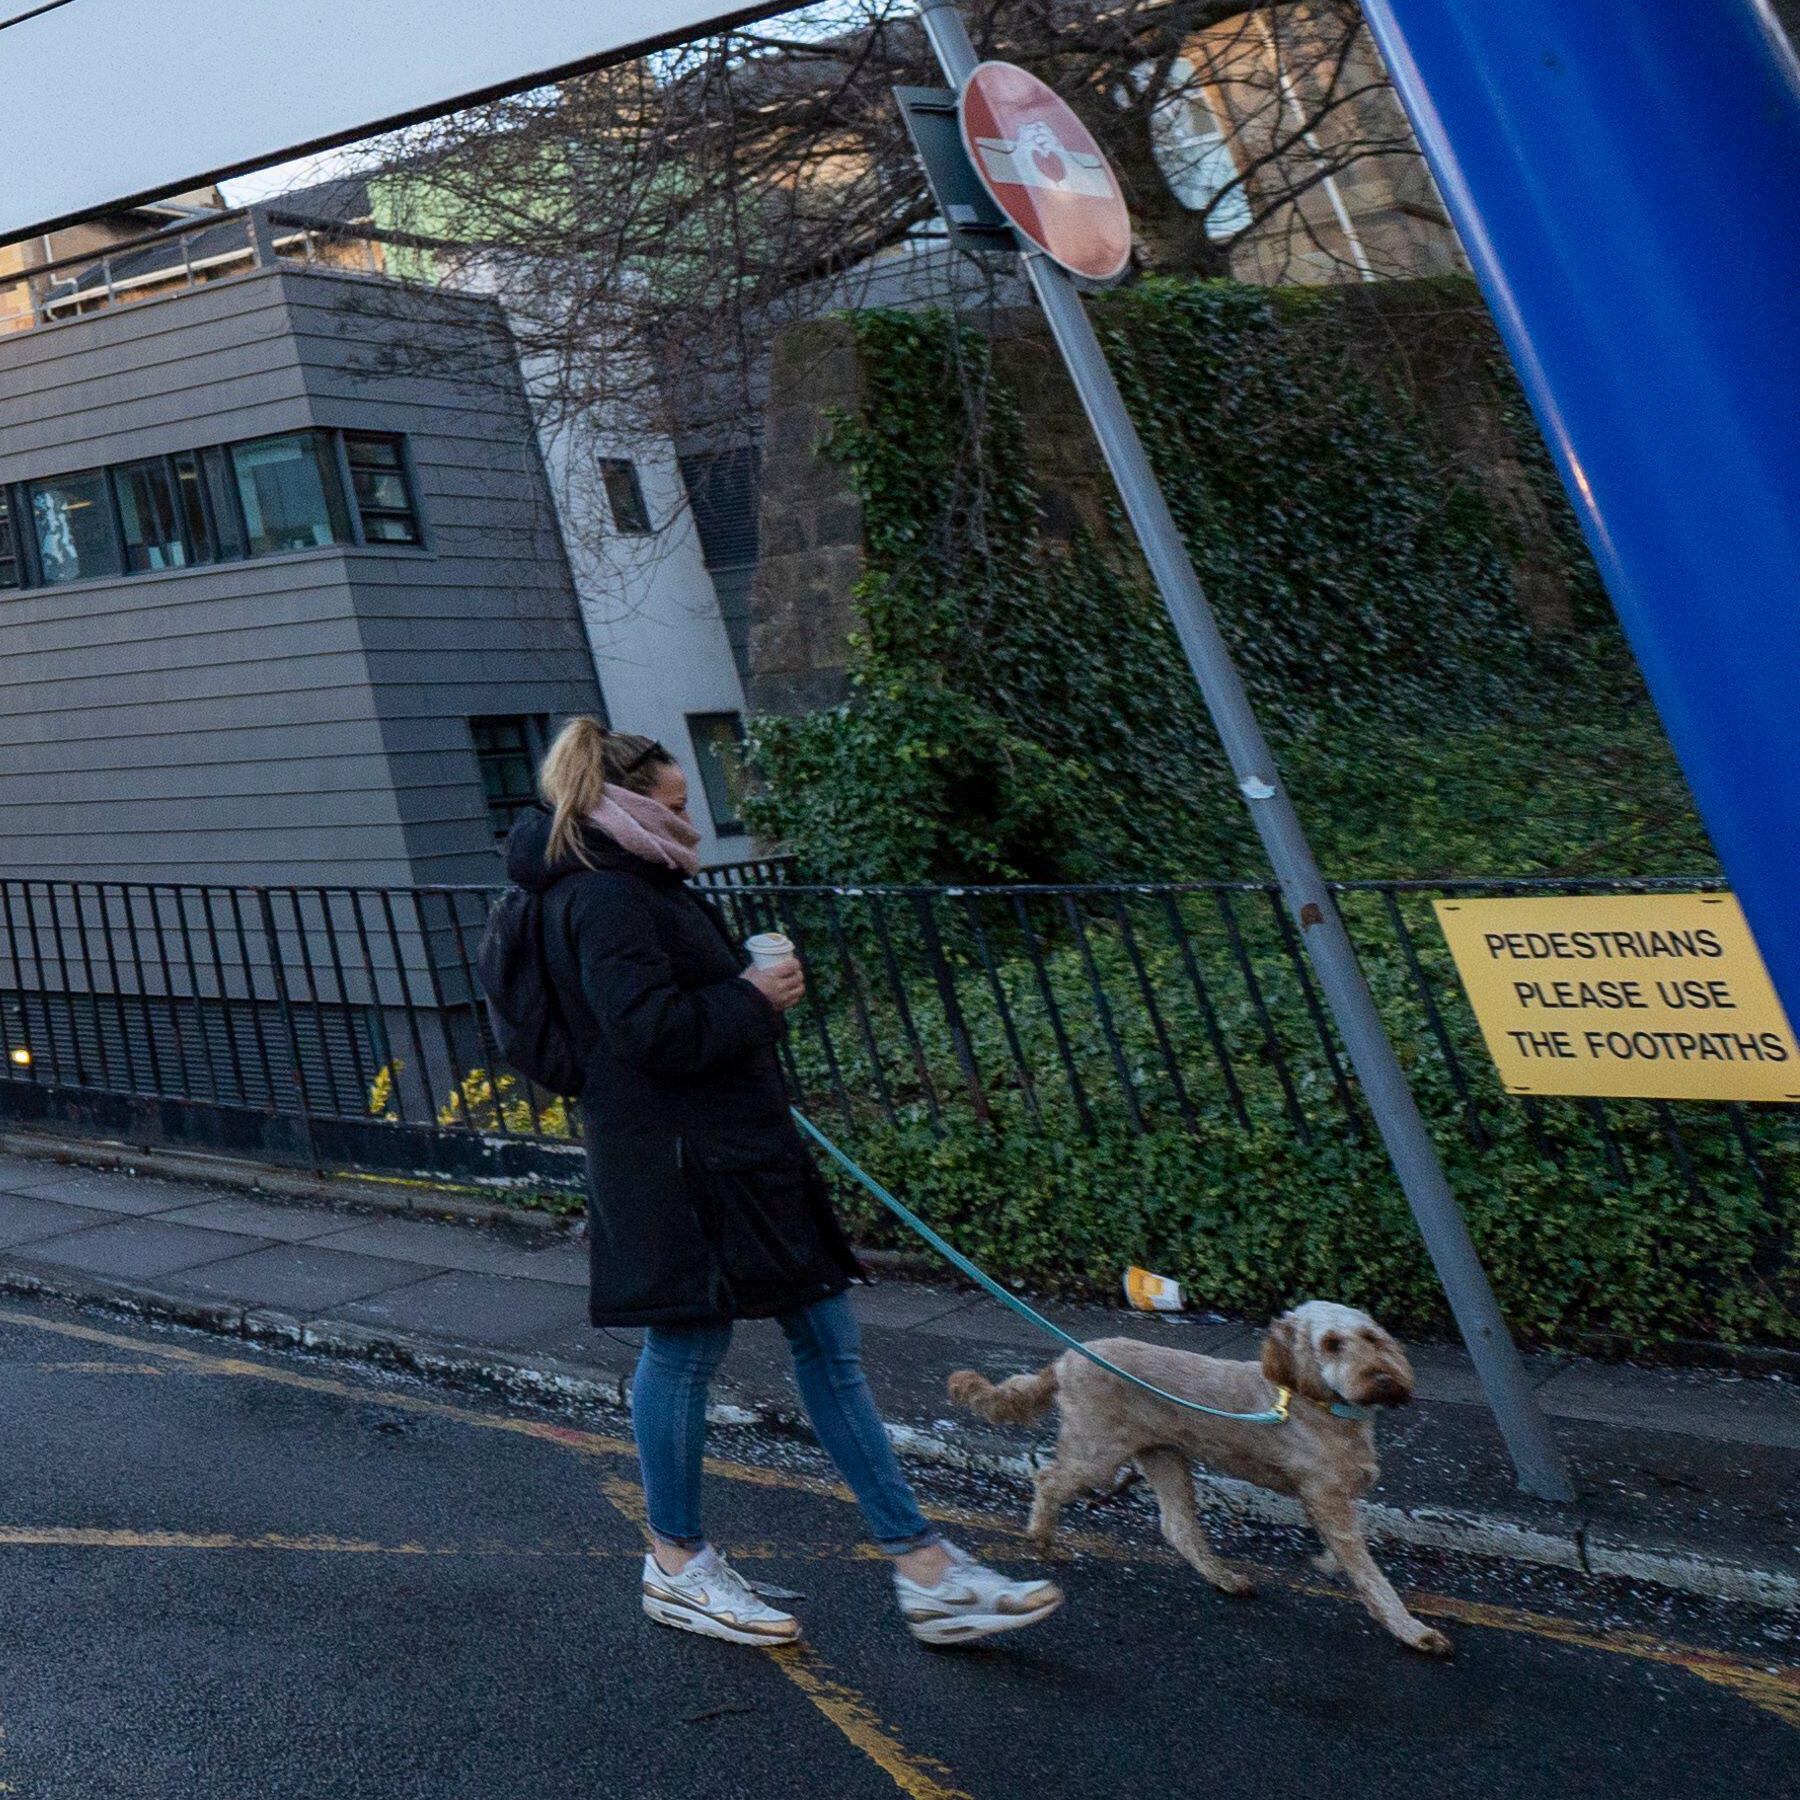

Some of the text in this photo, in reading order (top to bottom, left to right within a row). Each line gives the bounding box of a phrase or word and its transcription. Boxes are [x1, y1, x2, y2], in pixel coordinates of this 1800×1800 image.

[1484, 928, 1724, 960] PEDESTRIANS
[1512, 980, 1737, 1010] PLEASE USE
[1507, 1030, 1790, 1063] THE FOOTPATHS
